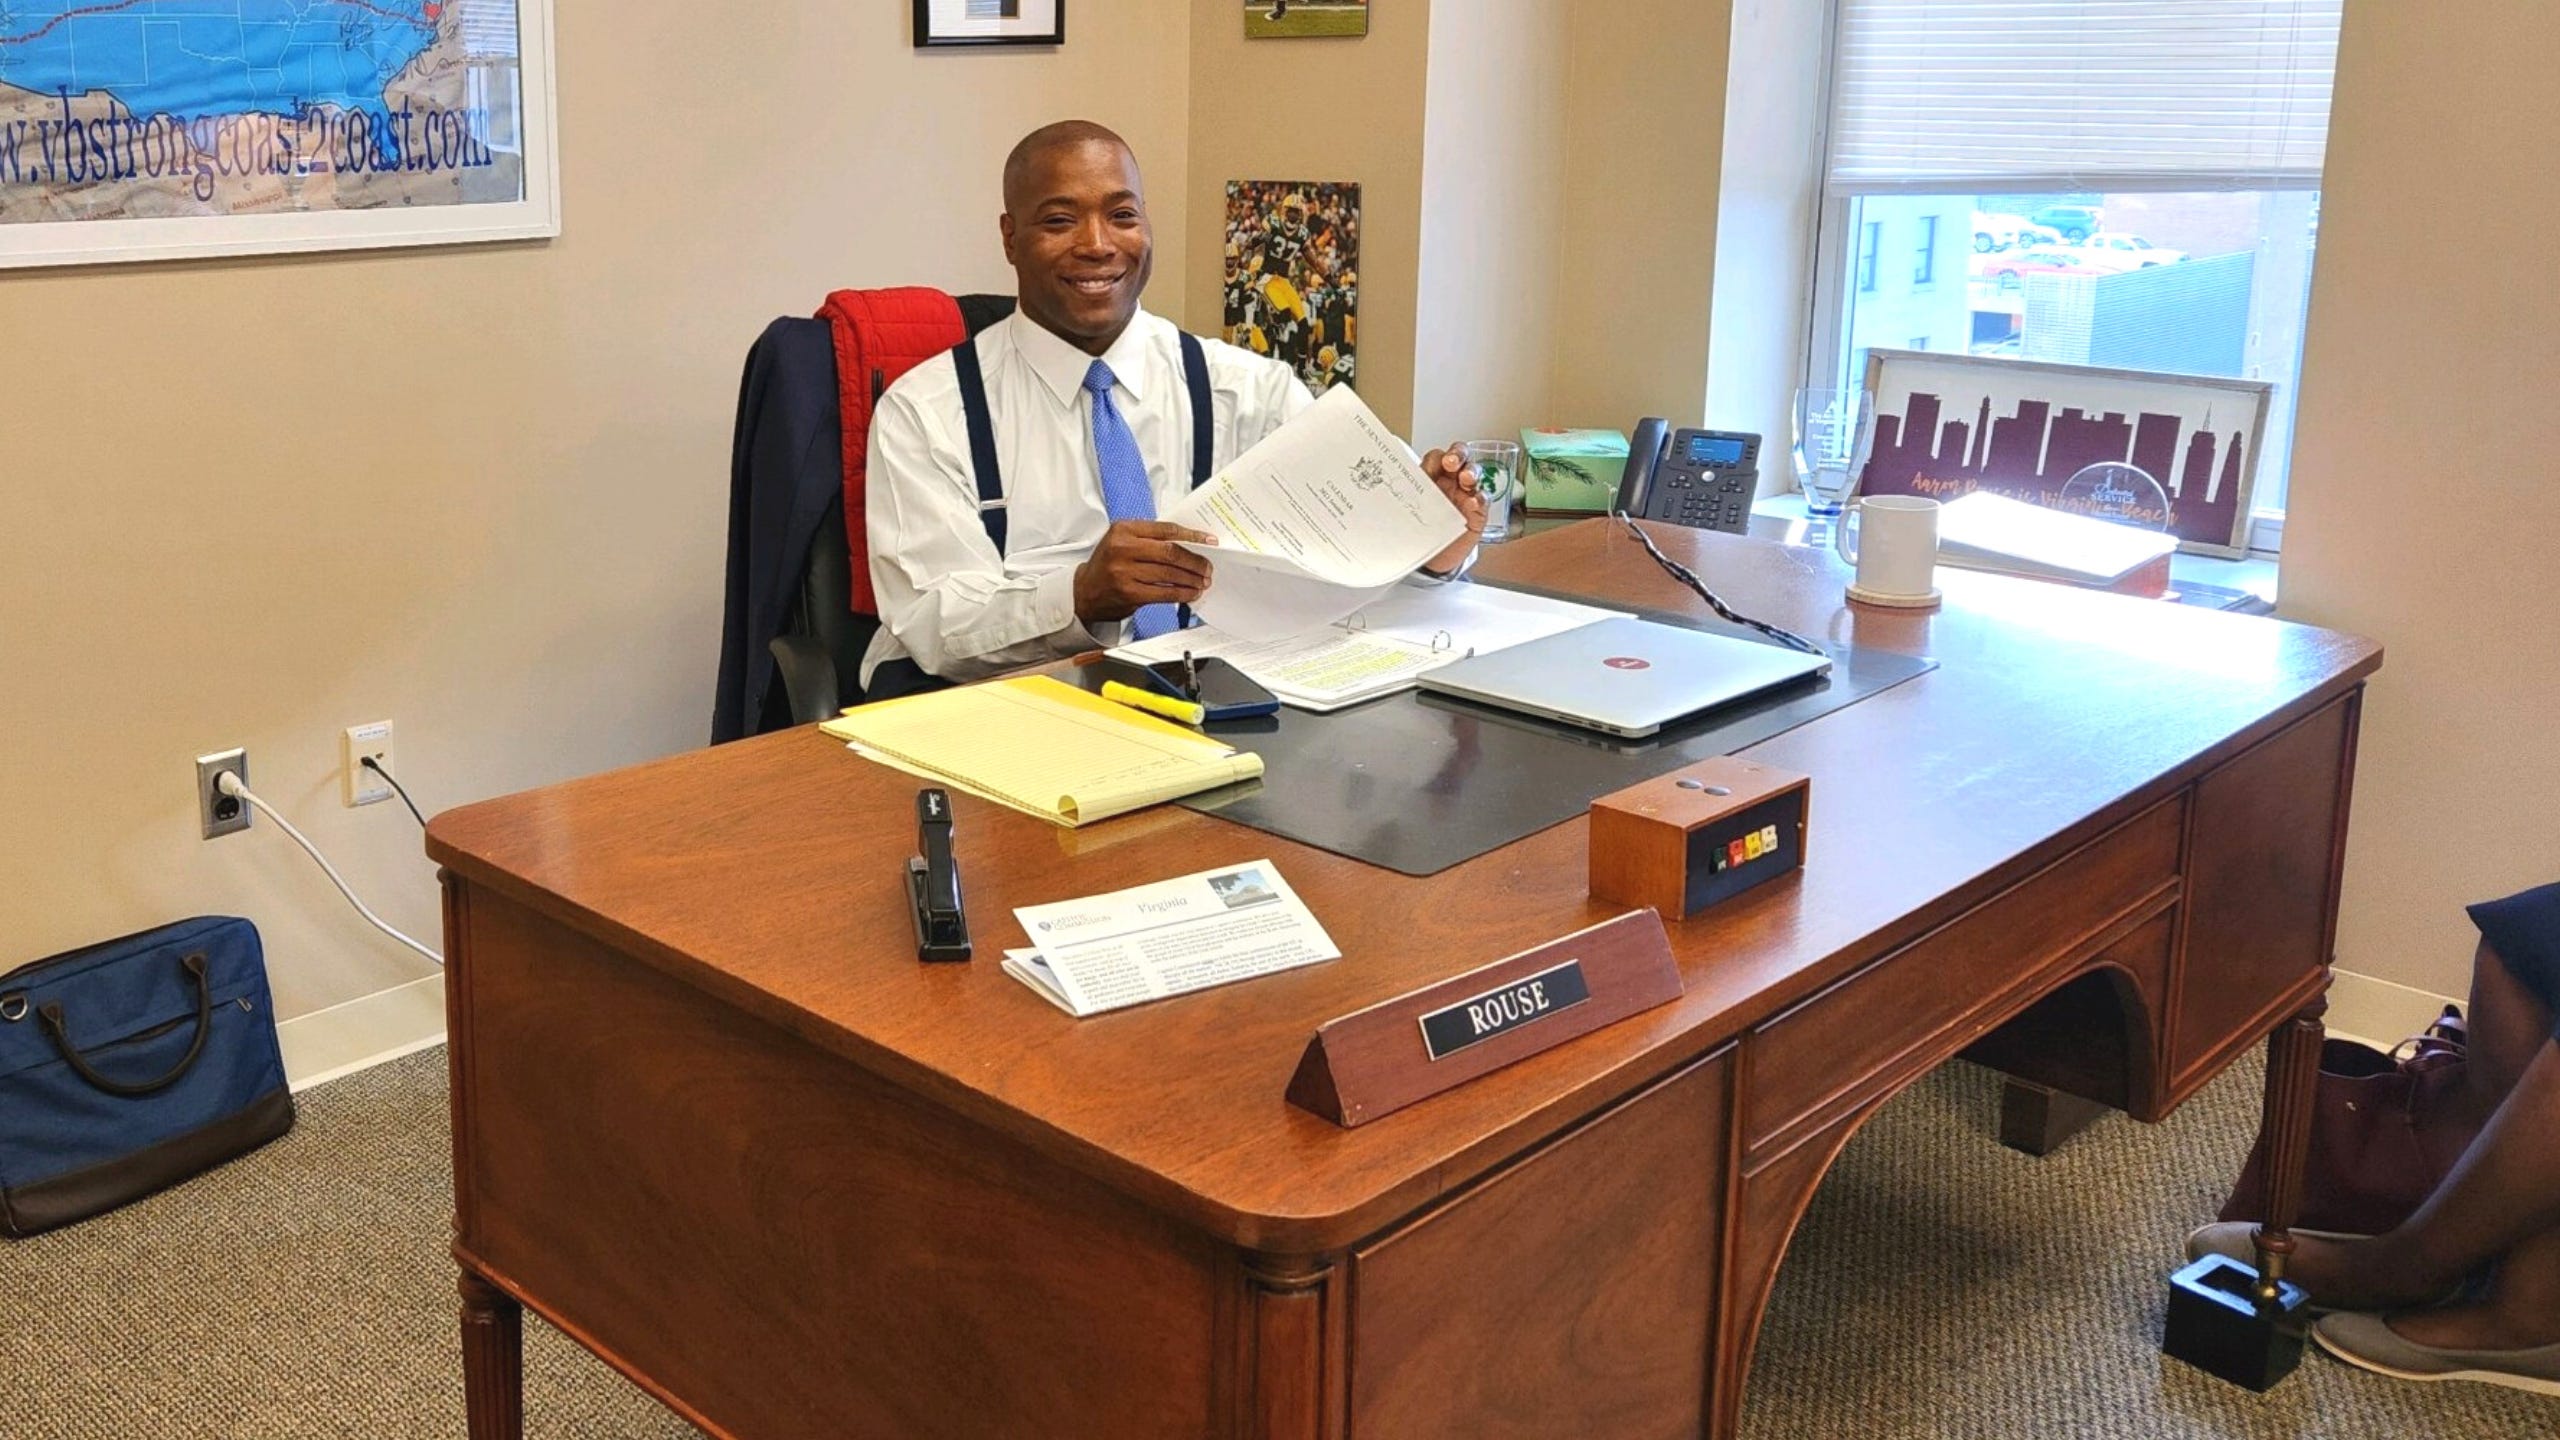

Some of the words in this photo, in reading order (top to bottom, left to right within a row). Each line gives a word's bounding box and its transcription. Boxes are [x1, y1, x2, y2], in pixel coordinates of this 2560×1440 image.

[1270, 235, 1300, 261] 37
[1352, 413, 1367, 429] THE
[1364, 426, 1391, 455] SENATE
[1387, 451, 1399, 464] OF
[1396, 461, 1427, 495] VIRGINIA
[1137, 895, 1188, 915] Virginia
[1468, 981, 1550, 1035] ROUSE
